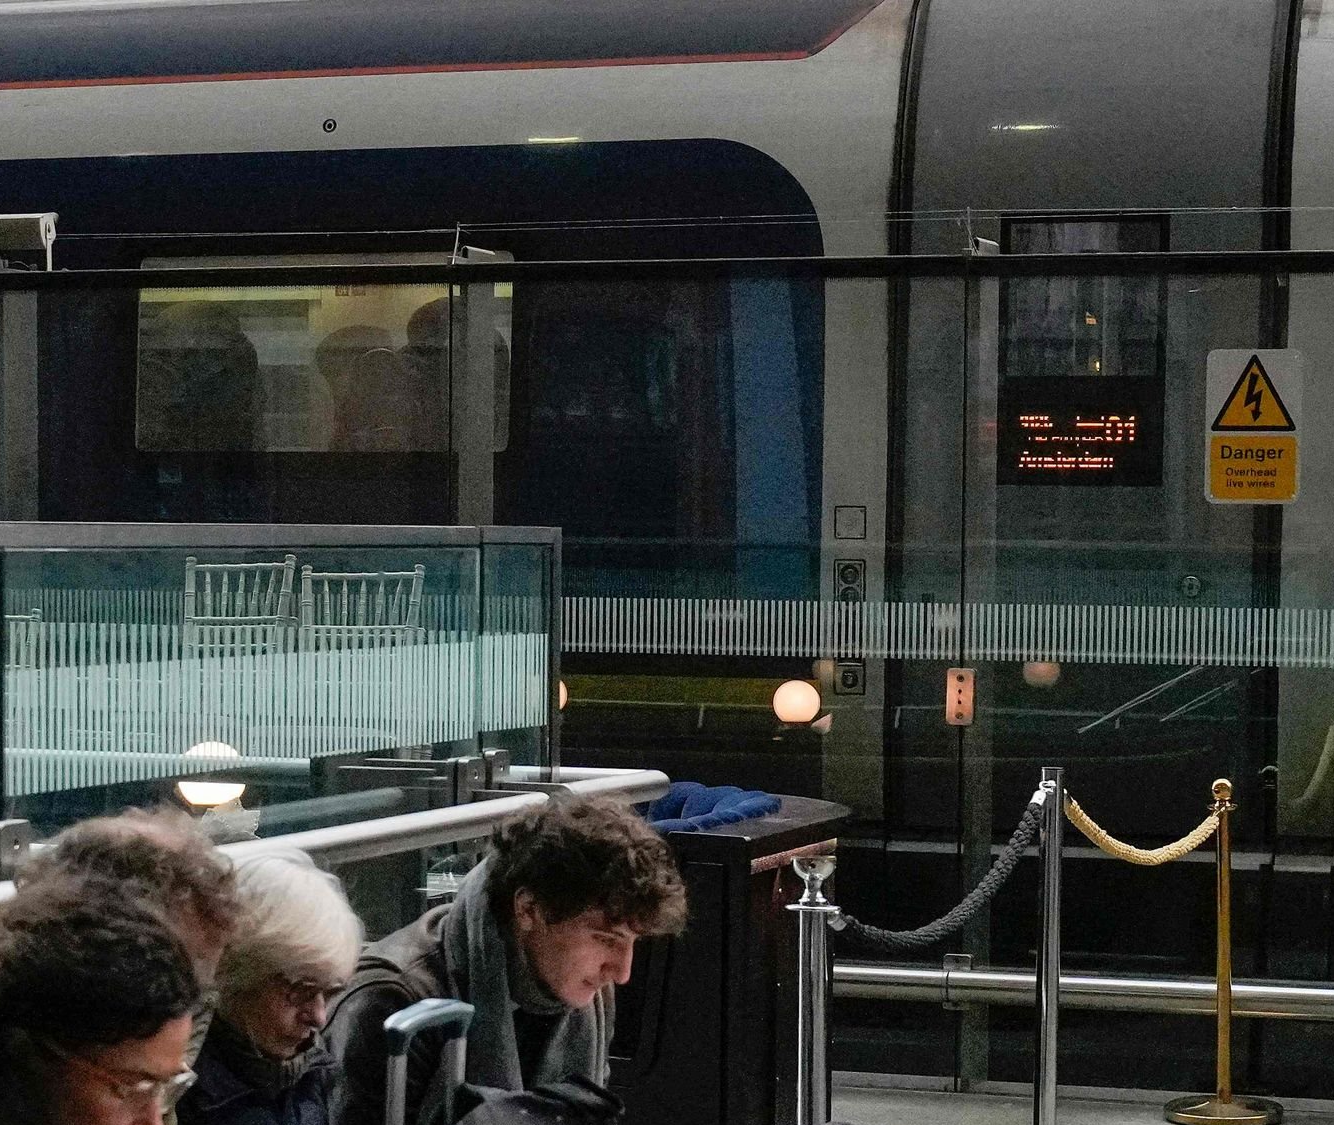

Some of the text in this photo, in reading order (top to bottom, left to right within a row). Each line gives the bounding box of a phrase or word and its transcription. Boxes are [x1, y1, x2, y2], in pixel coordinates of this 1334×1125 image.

[1221, 445, 1284, 462] Danger
[1225, 467, 1277, 477] Overhead
[1226, 478, 1276, 488] live wires
